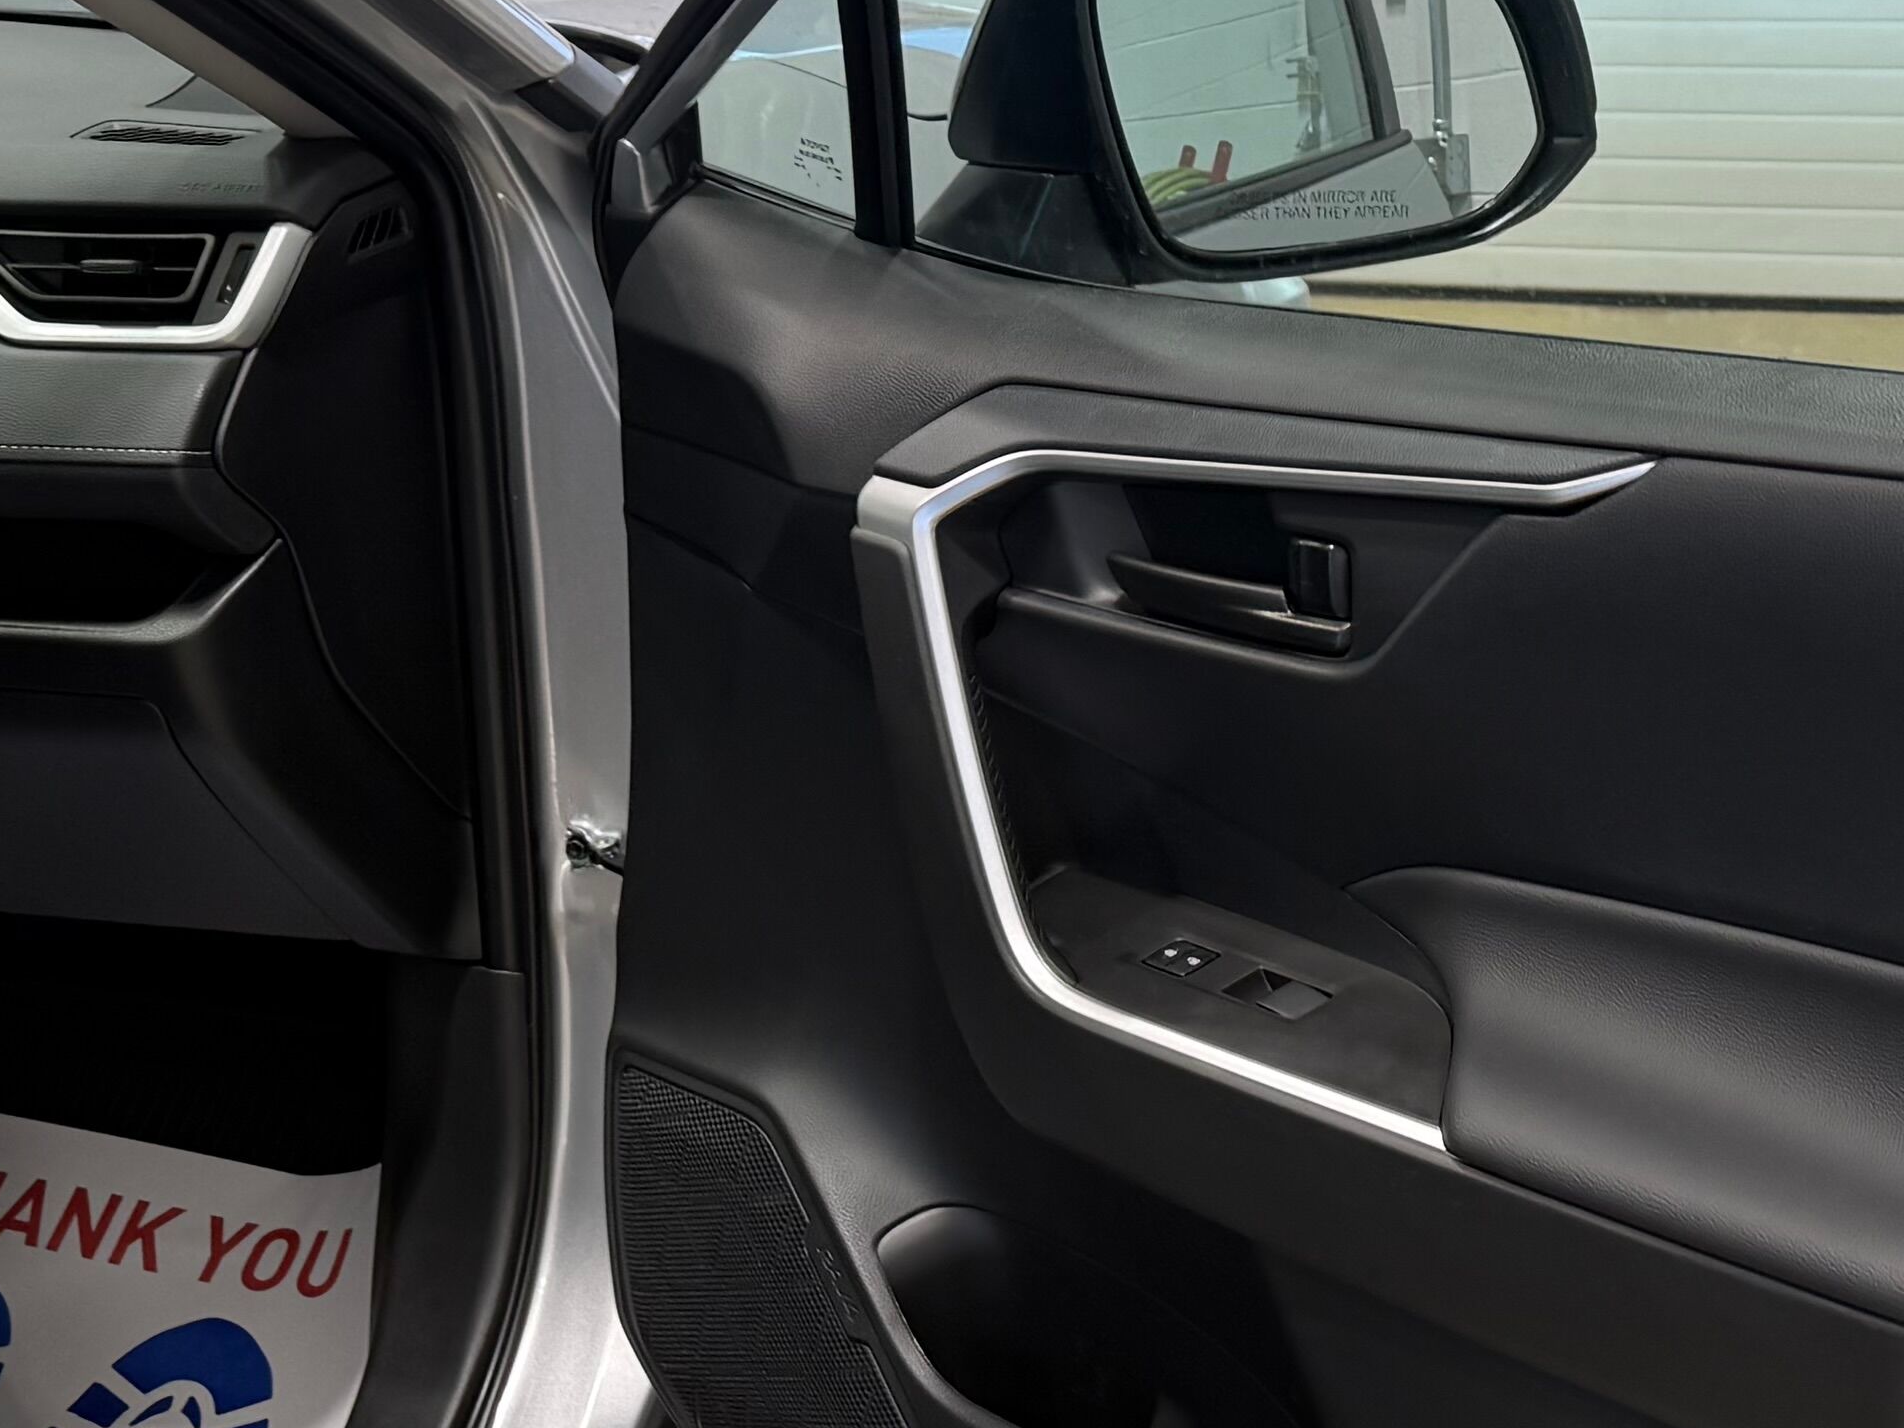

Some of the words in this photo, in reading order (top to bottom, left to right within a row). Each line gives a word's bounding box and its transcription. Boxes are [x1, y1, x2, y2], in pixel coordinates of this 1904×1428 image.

[1310, 190, 1364, 204] MIRROR
[1369, 189, 1397, 204] ARE
[1275, 206, 1311, 220] THAN
[1315, 205, 1349, 220] THEY
[1354, 203, 1410, 219] APPEAR
[198, 1215, 353, 1298] YOU
